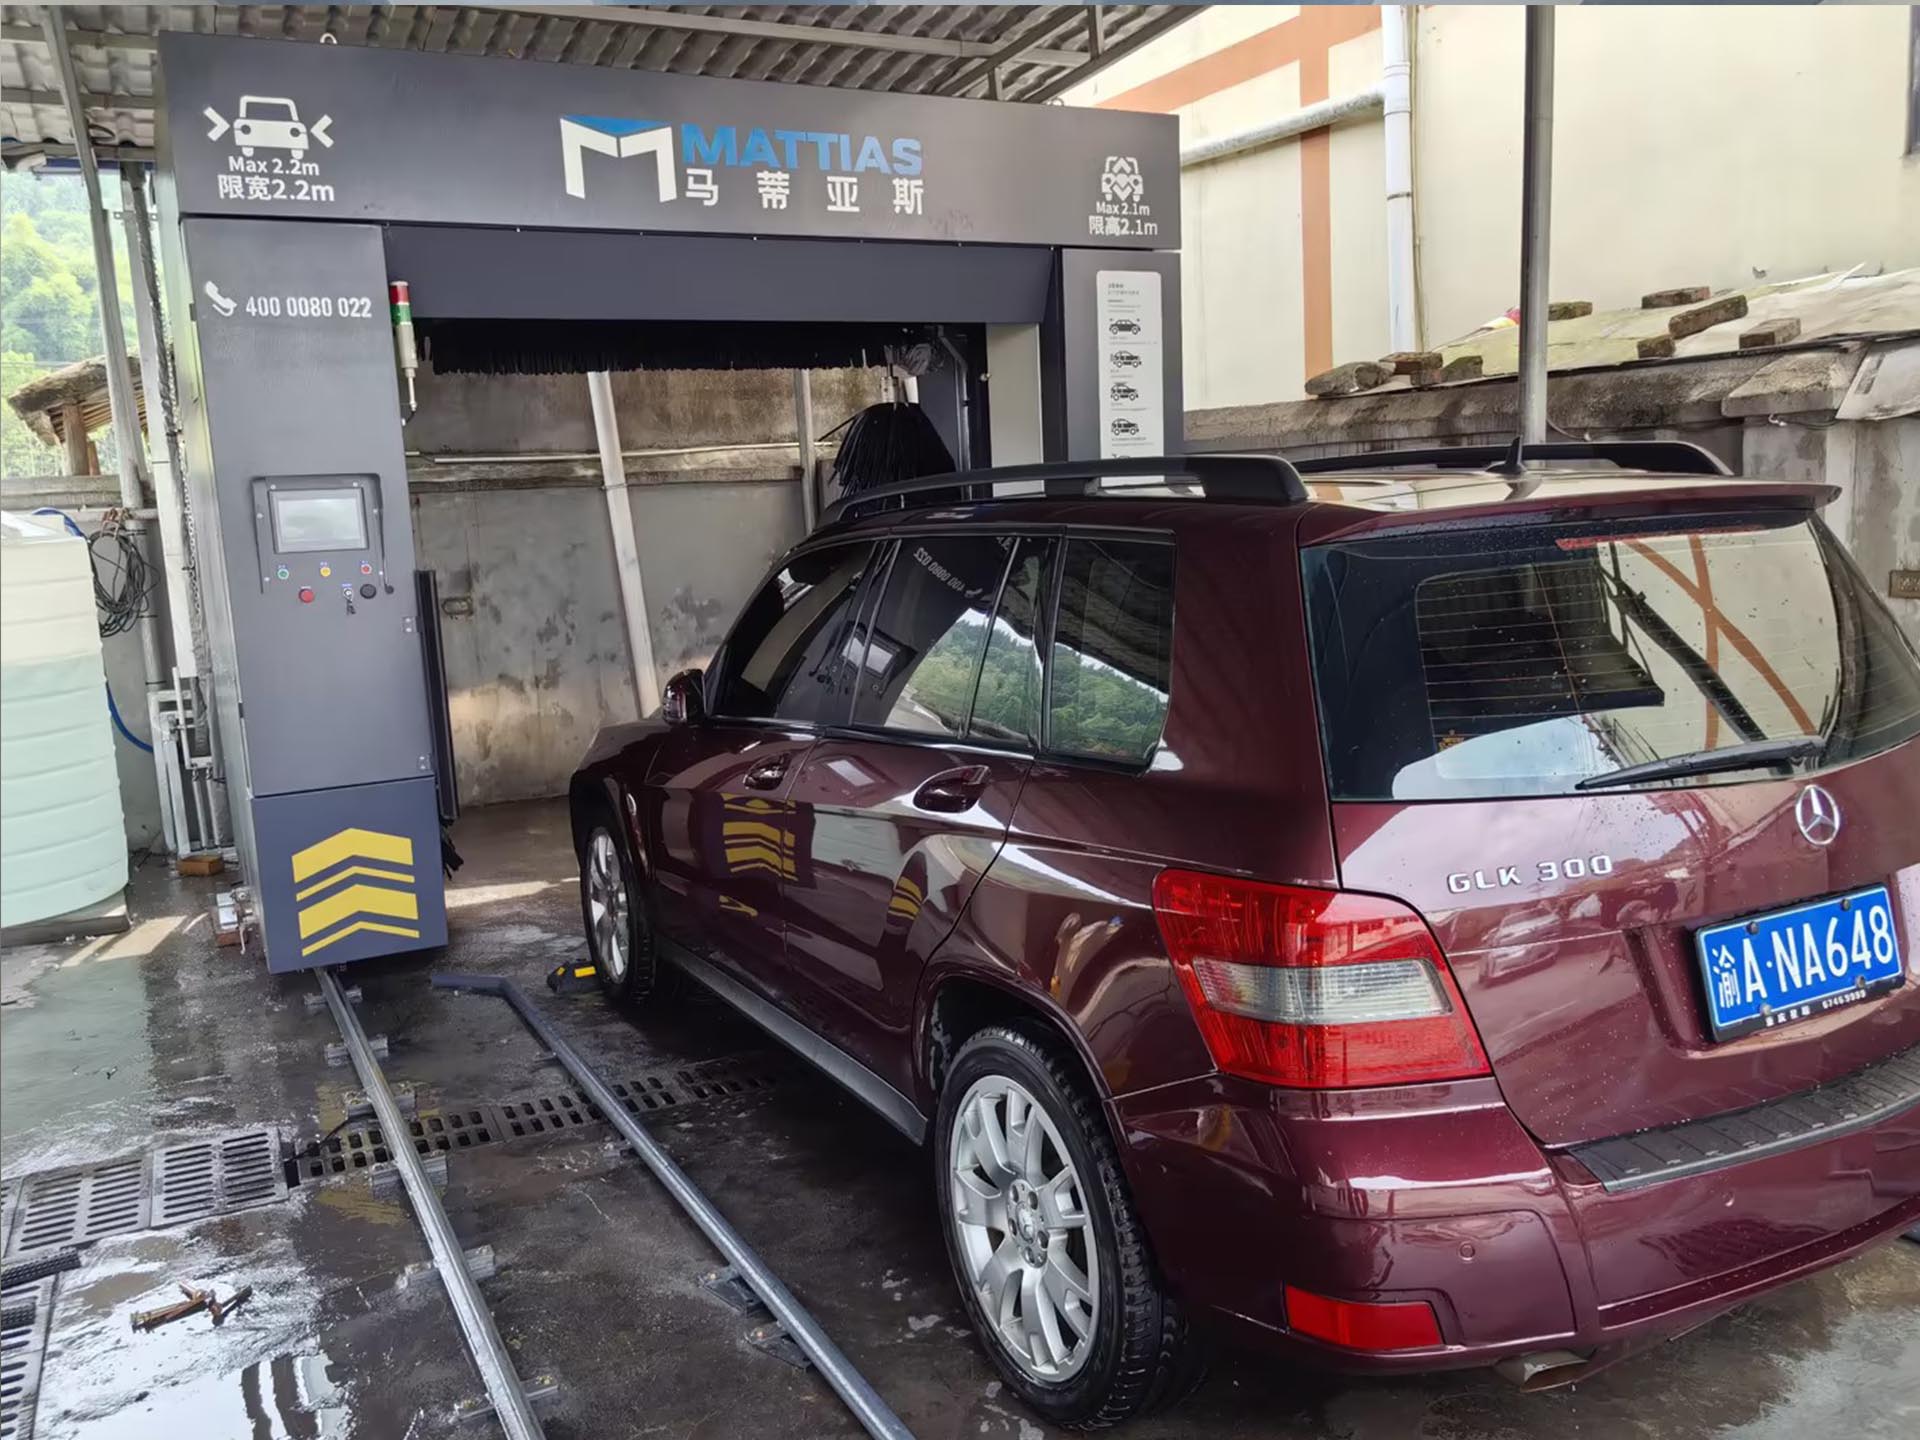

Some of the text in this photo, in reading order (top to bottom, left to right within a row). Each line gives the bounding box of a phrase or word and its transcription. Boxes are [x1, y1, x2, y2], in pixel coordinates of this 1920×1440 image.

[681, 122, 924, 177] MATTIAS
[228, 156, 320, 176] Max 2.2m
[217, 174, 335, 201] 限宽2.2m
[685, 167, 924, 216] 马蒂亚斯
[1096, 201, 1150, 216] Max 2.1m
[1088, 215, 1158, 236] 限高2.1m
[246, 296, 372, 318] 400 0080 022
[1447, 854, 1613, 894] GLK 300
